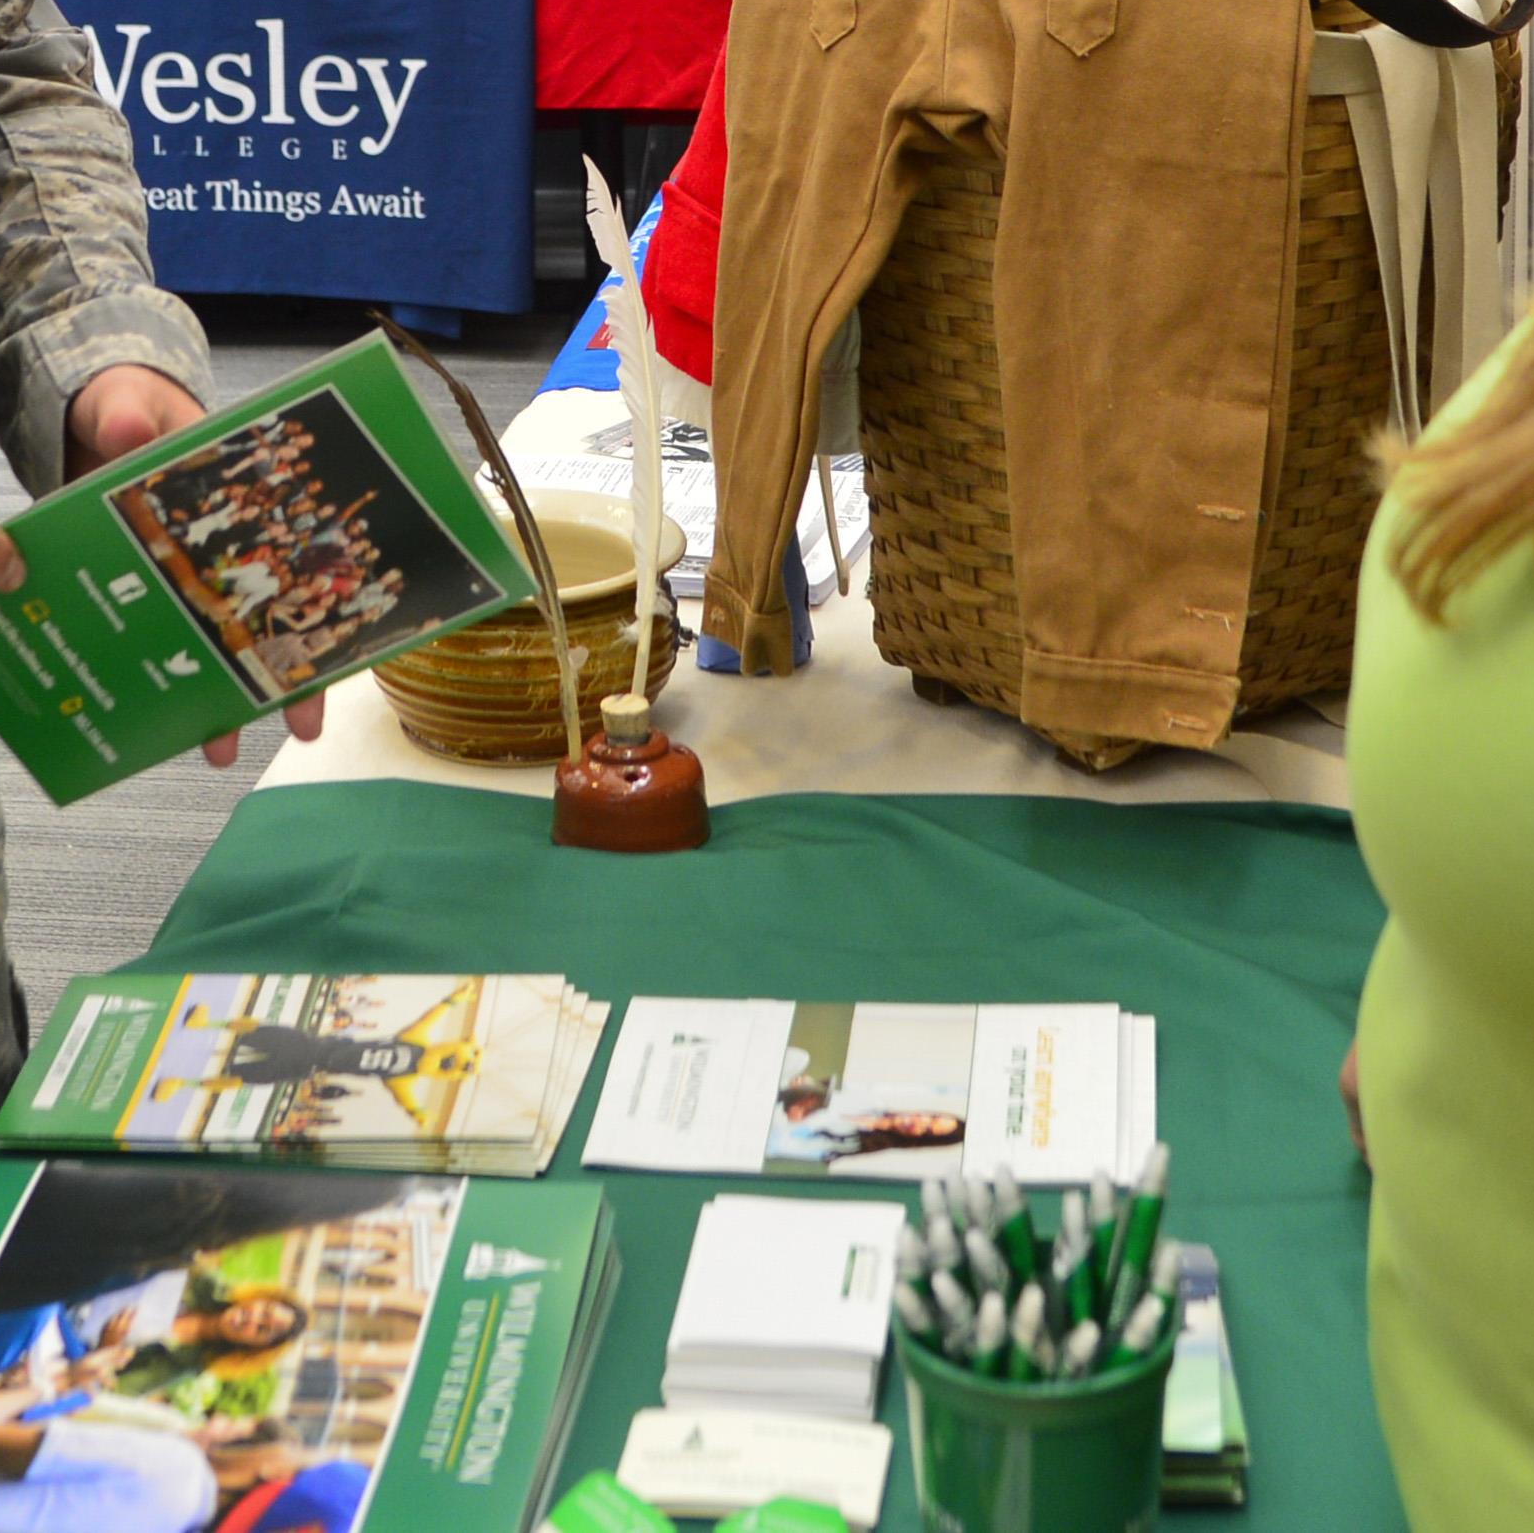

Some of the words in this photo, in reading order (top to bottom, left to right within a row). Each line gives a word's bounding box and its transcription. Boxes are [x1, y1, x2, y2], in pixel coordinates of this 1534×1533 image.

[152, 135, 348, 160] LLEGE
[142, 183, 199, 211] eat
[205, 178, 322, 222] Things
[328, 184, 426, 219] Await
[458, 1280, 543, 1485] WILMINGTON
